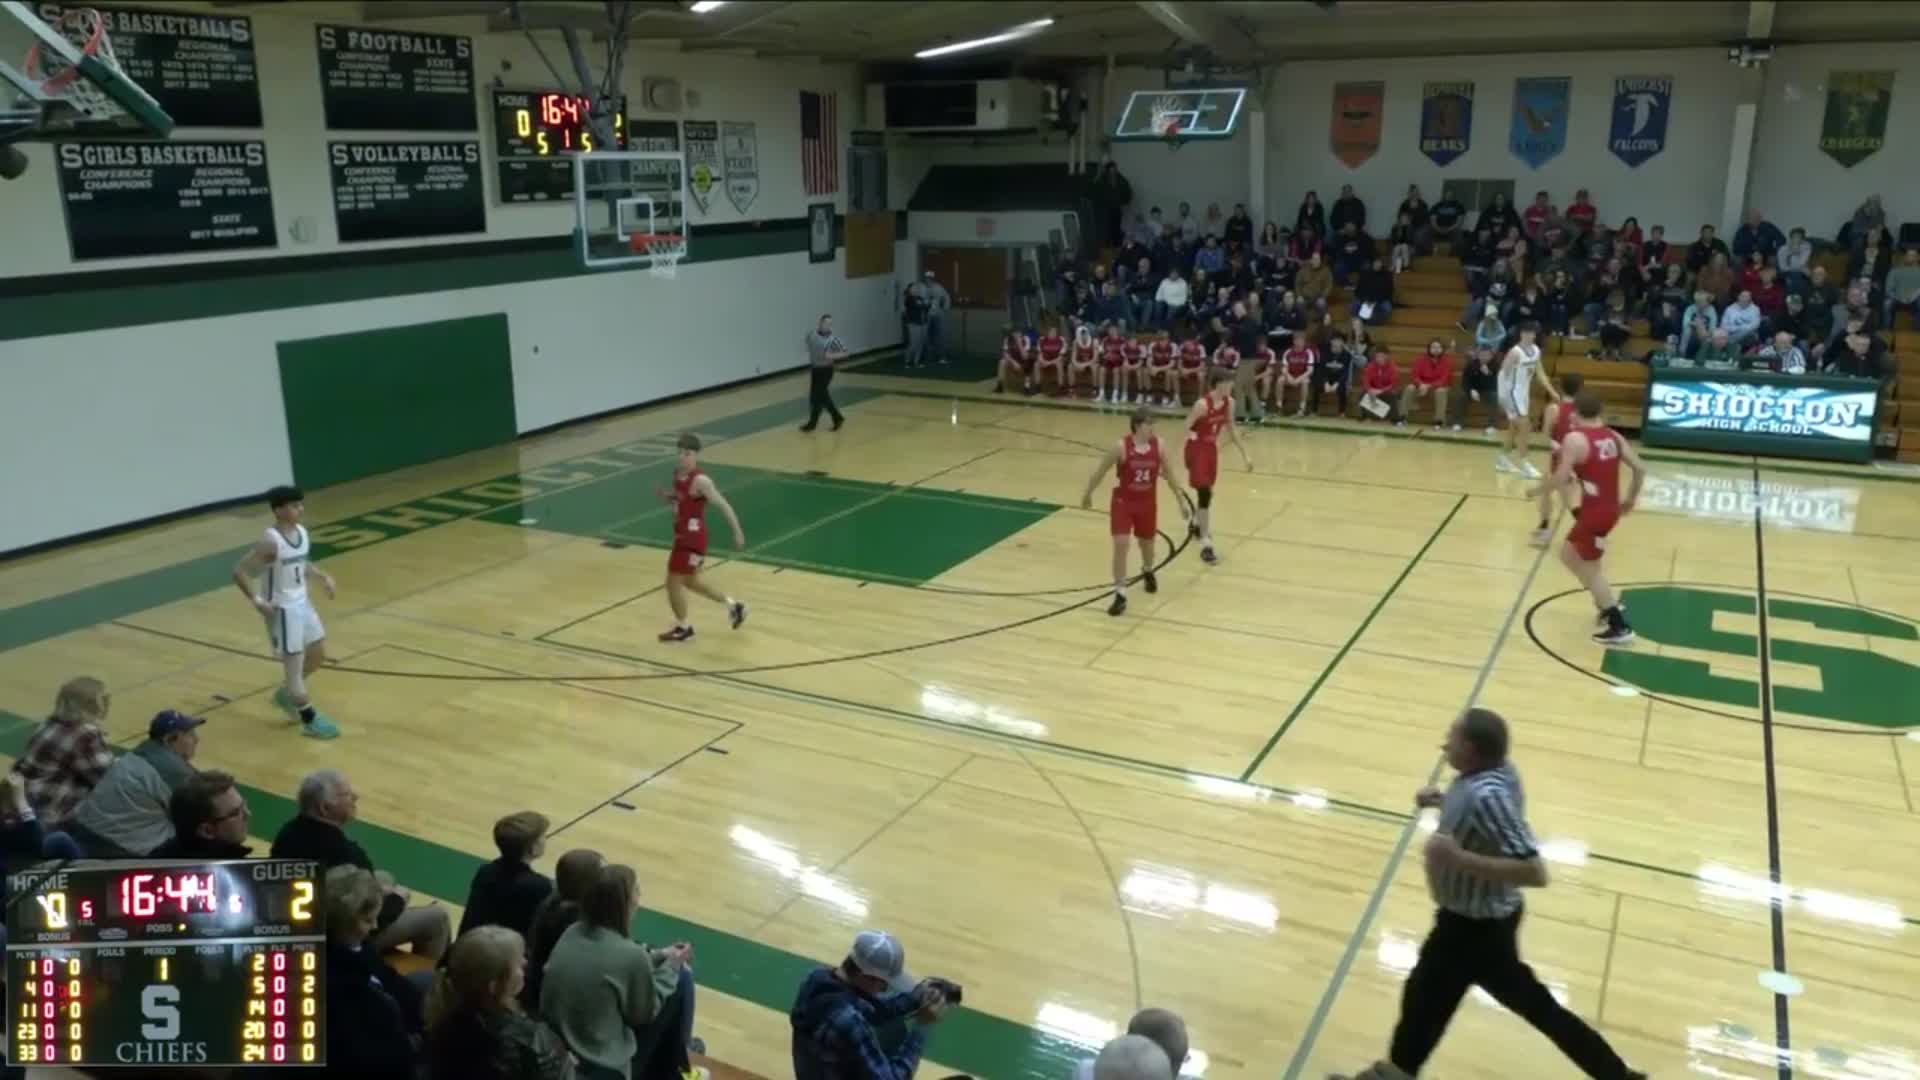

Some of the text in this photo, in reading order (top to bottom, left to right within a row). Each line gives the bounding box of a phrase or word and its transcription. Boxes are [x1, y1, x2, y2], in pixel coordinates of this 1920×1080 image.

[117, 12, 230, 37] BASKETBALL
[230, 19, 249, 41] S
[319, 27, 470, 57] S FOOTBALL S
[515, 109, 532, 138] 0
[536, 131, 549, 155] 5
[564, 128, 572, 149] 1
[580, 131, 592, 155] 5
[61, 144, 264, 169] S GIRLS BASKETBALL S
[333, 143, 478, 165] S VOLLEYBALL S
[1664, 391, 1860, 426] SHIOCTON
[1701, 417, 1741, 431] HIGH
[1134, 469, 1151, 483] 24
